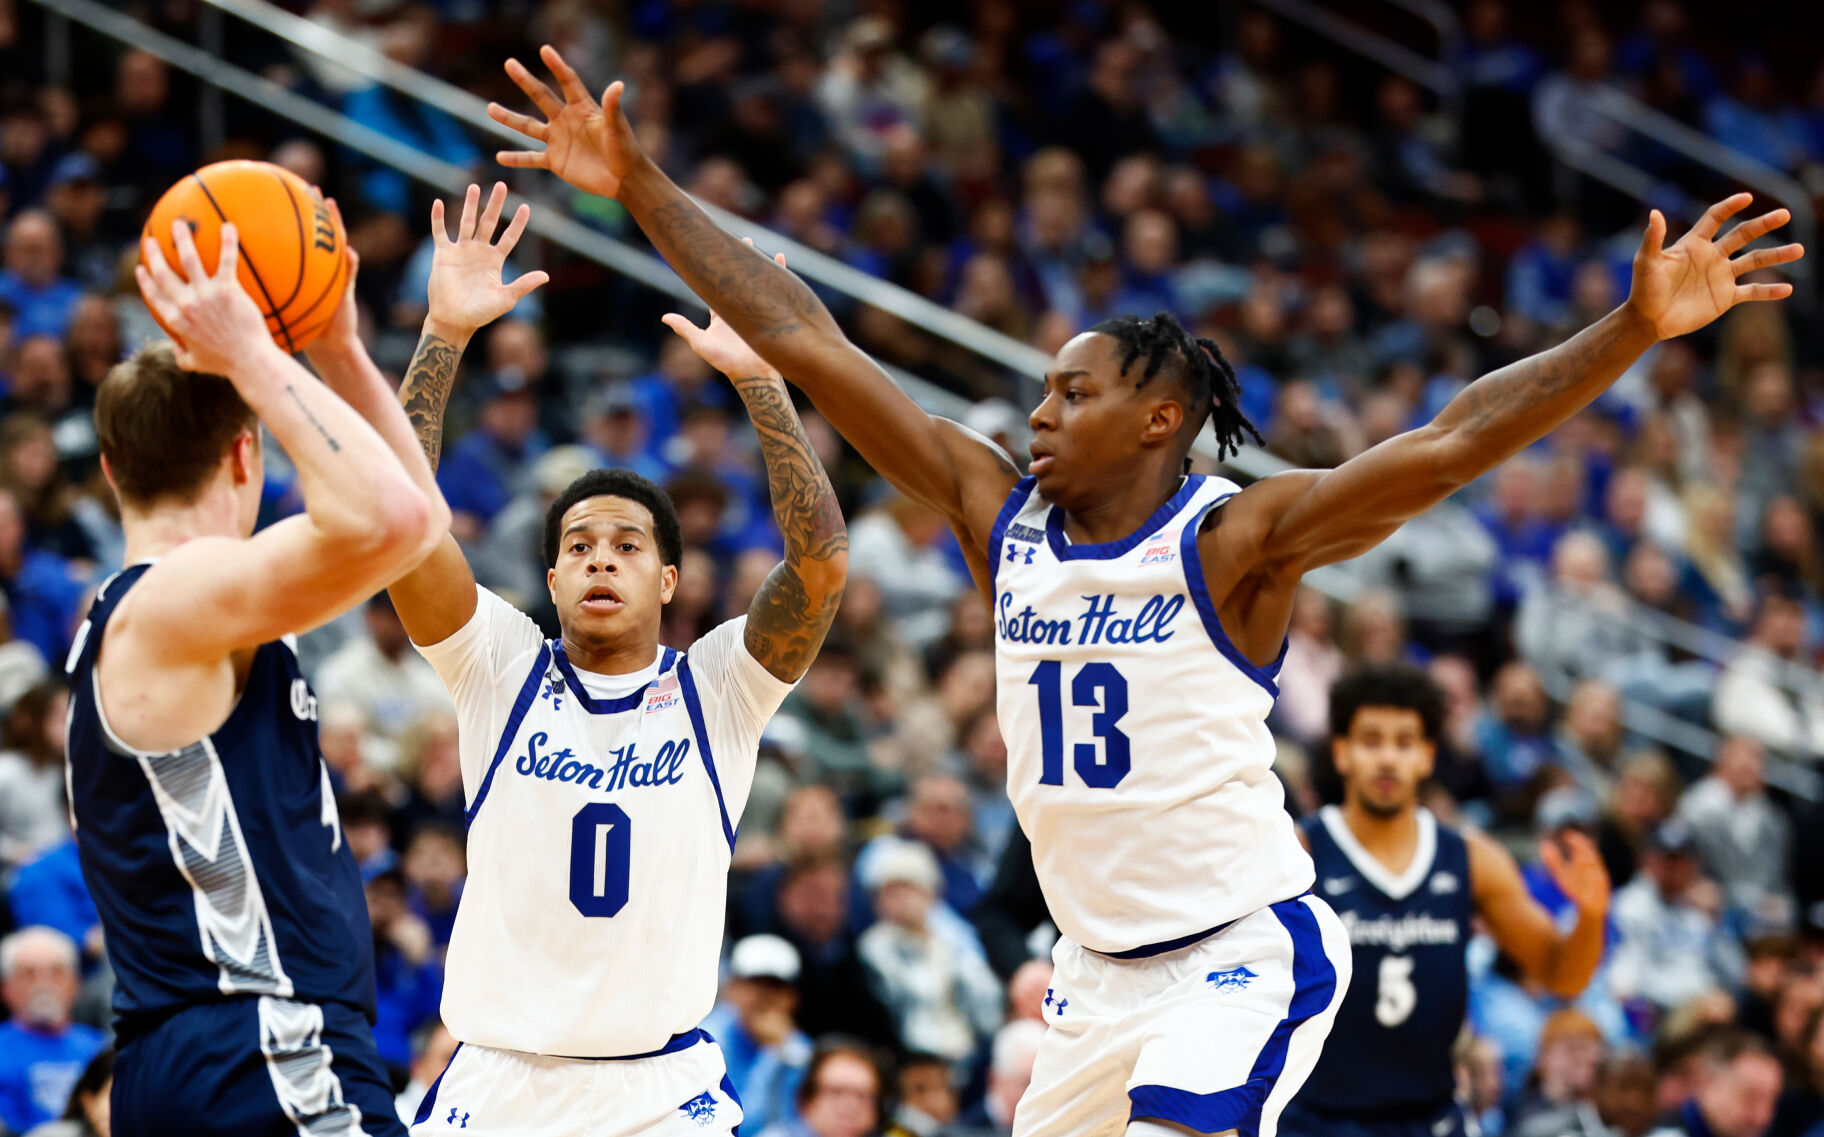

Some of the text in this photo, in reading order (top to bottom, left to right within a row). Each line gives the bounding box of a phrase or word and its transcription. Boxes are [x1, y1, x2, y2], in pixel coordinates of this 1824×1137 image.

[1140, 553, 1176, 564] EAST
[1145, 546, 1170, 556] BIG
[999, 592, 1186, 645] Seton Hall
[646, 698, 680, 711] EAST
[648, 693, 672, 704] BIG
[1028, 660, 1131, 789] 13
[516, 731, 691, 792] Seton Hall
[569, 802, 632, 918] 0
[1375, 955, 1417, 1027] 5
